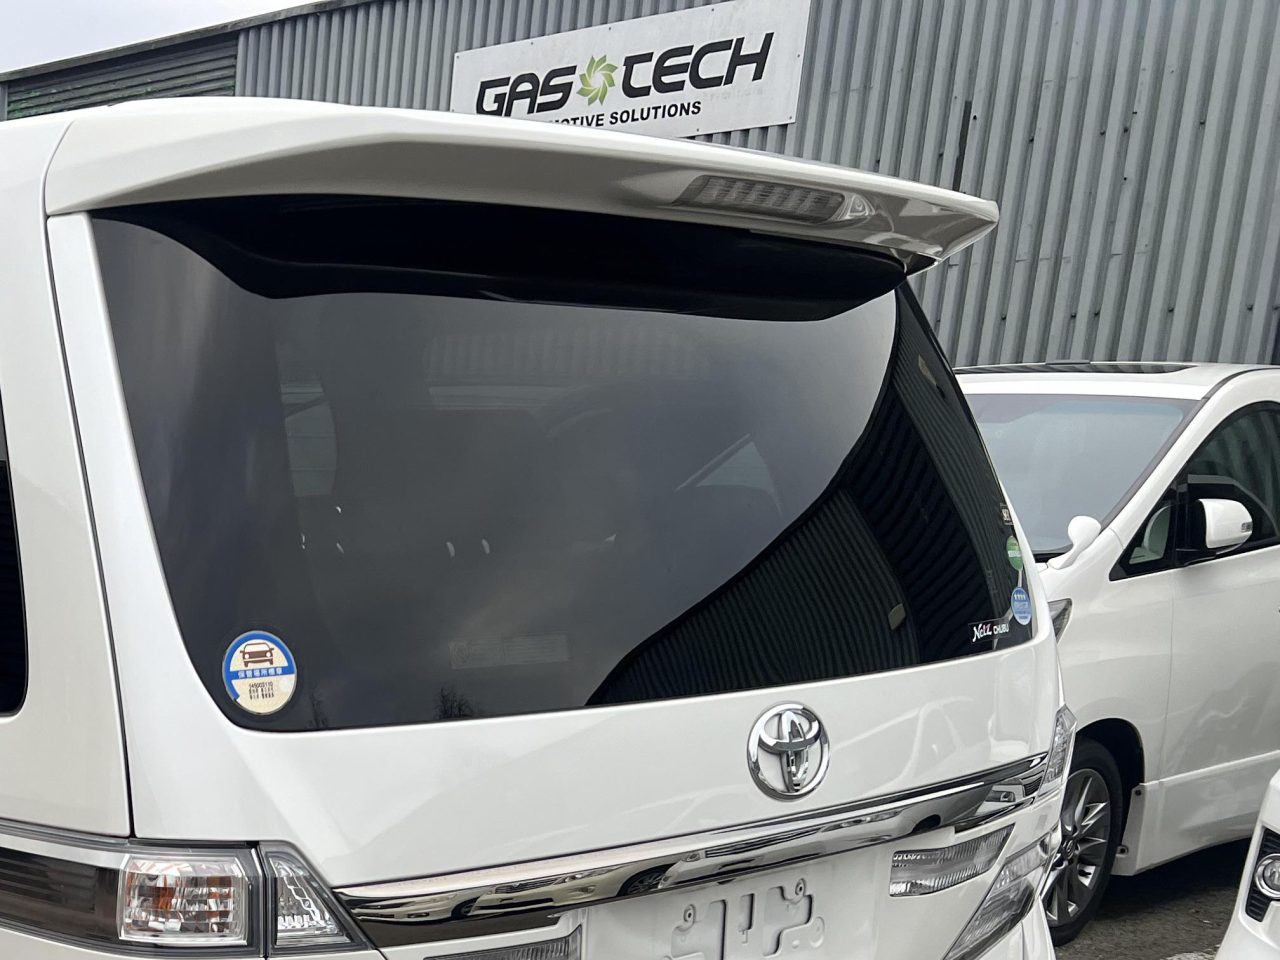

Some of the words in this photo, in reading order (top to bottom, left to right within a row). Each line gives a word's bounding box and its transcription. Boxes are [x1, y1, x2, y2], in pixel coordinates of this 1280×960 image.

[476, 65, 577, 118] GAS
[621, 32, 775, 99] TECH
[609, 101, 702, 125] SOLUTIONS
